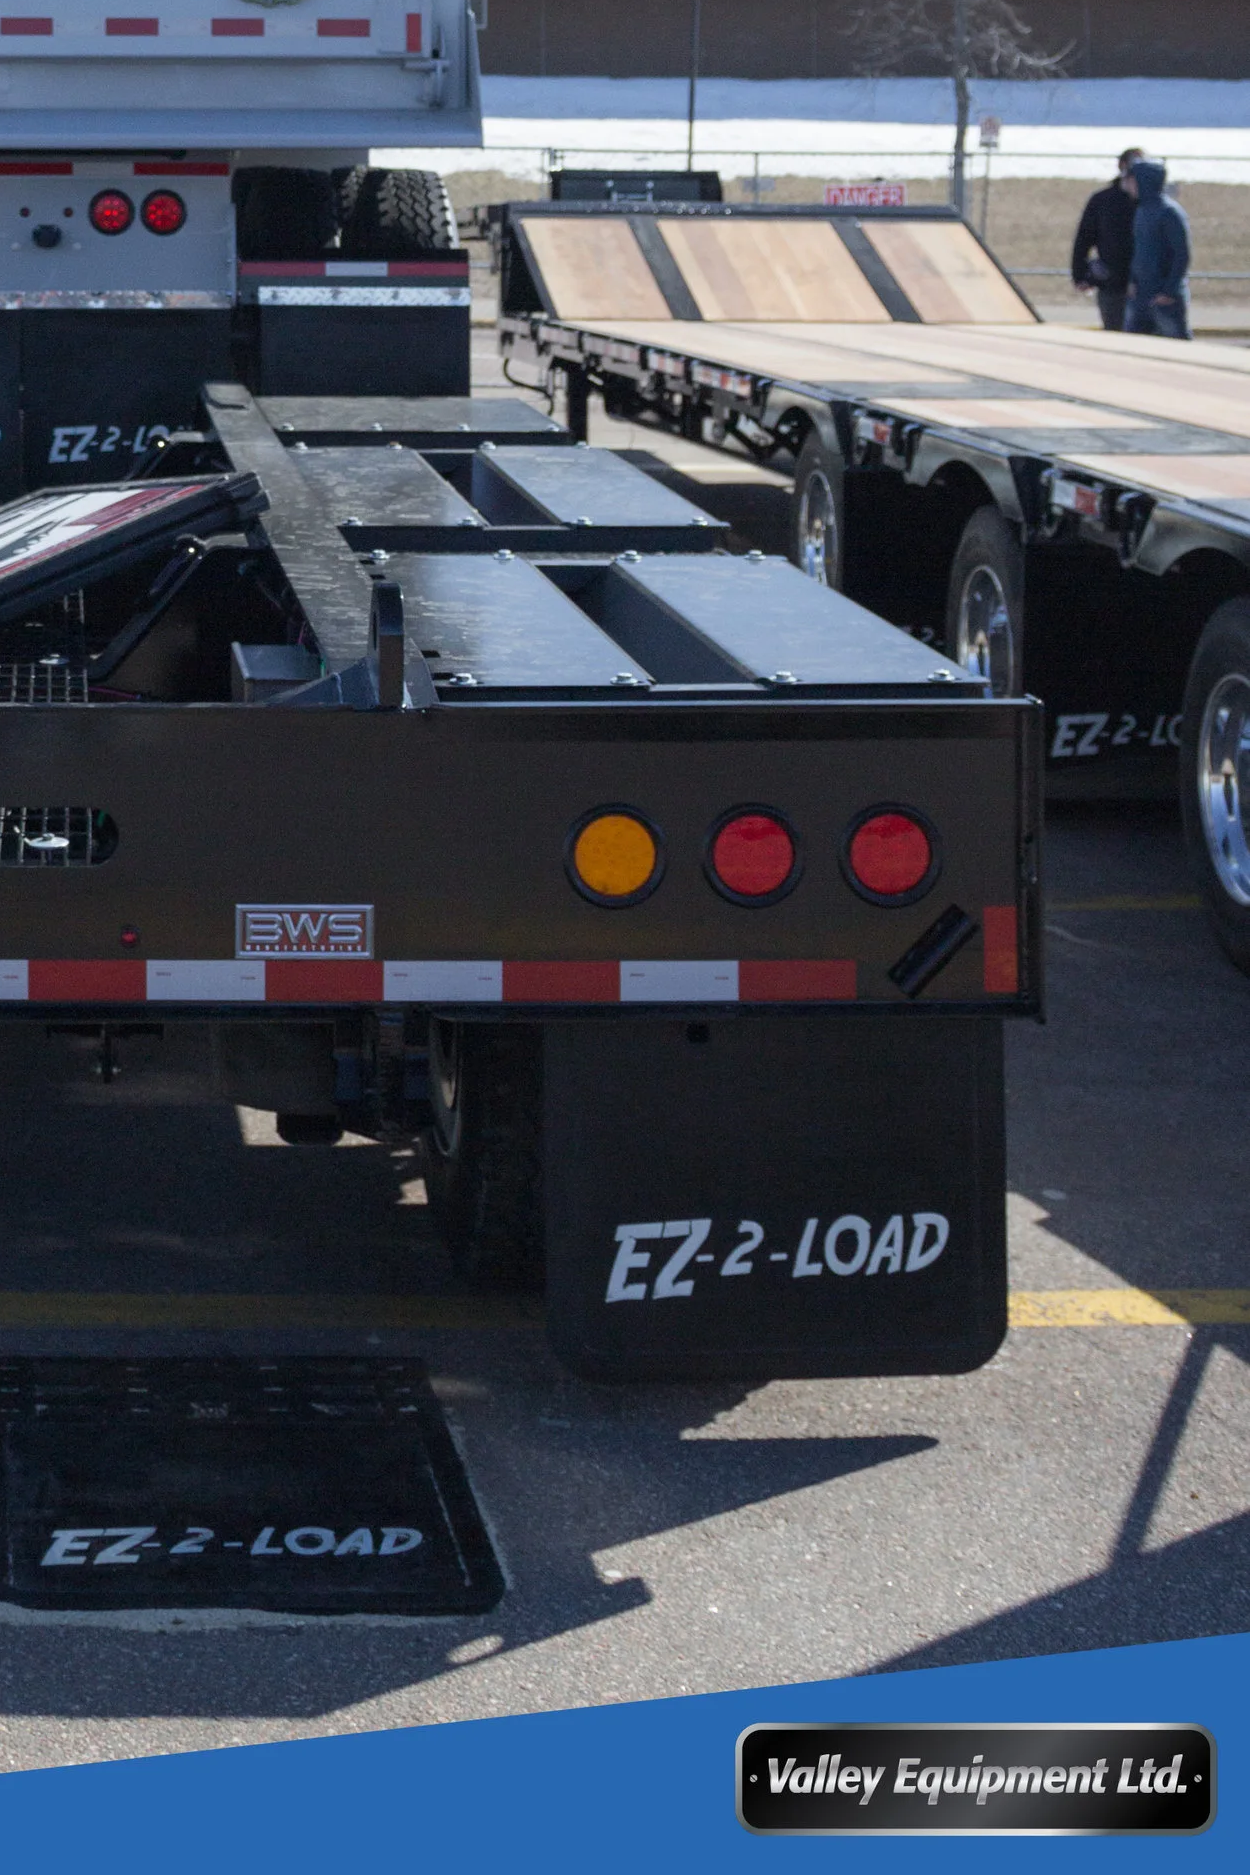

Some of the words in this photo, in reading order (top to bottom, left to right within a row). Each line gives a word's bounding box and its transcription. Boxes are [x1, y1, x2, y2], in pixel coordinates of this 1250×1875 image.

[829, 186, 903, 206] DANGER
[1052, 713, 1185, 758] EZ-2-LO
[245, 913, 363, 944] BWS
[605, 1212, 950, 1303] EZ-2-LOAD
[40, 1526, 424, 1567] EZ-2-LOAD
